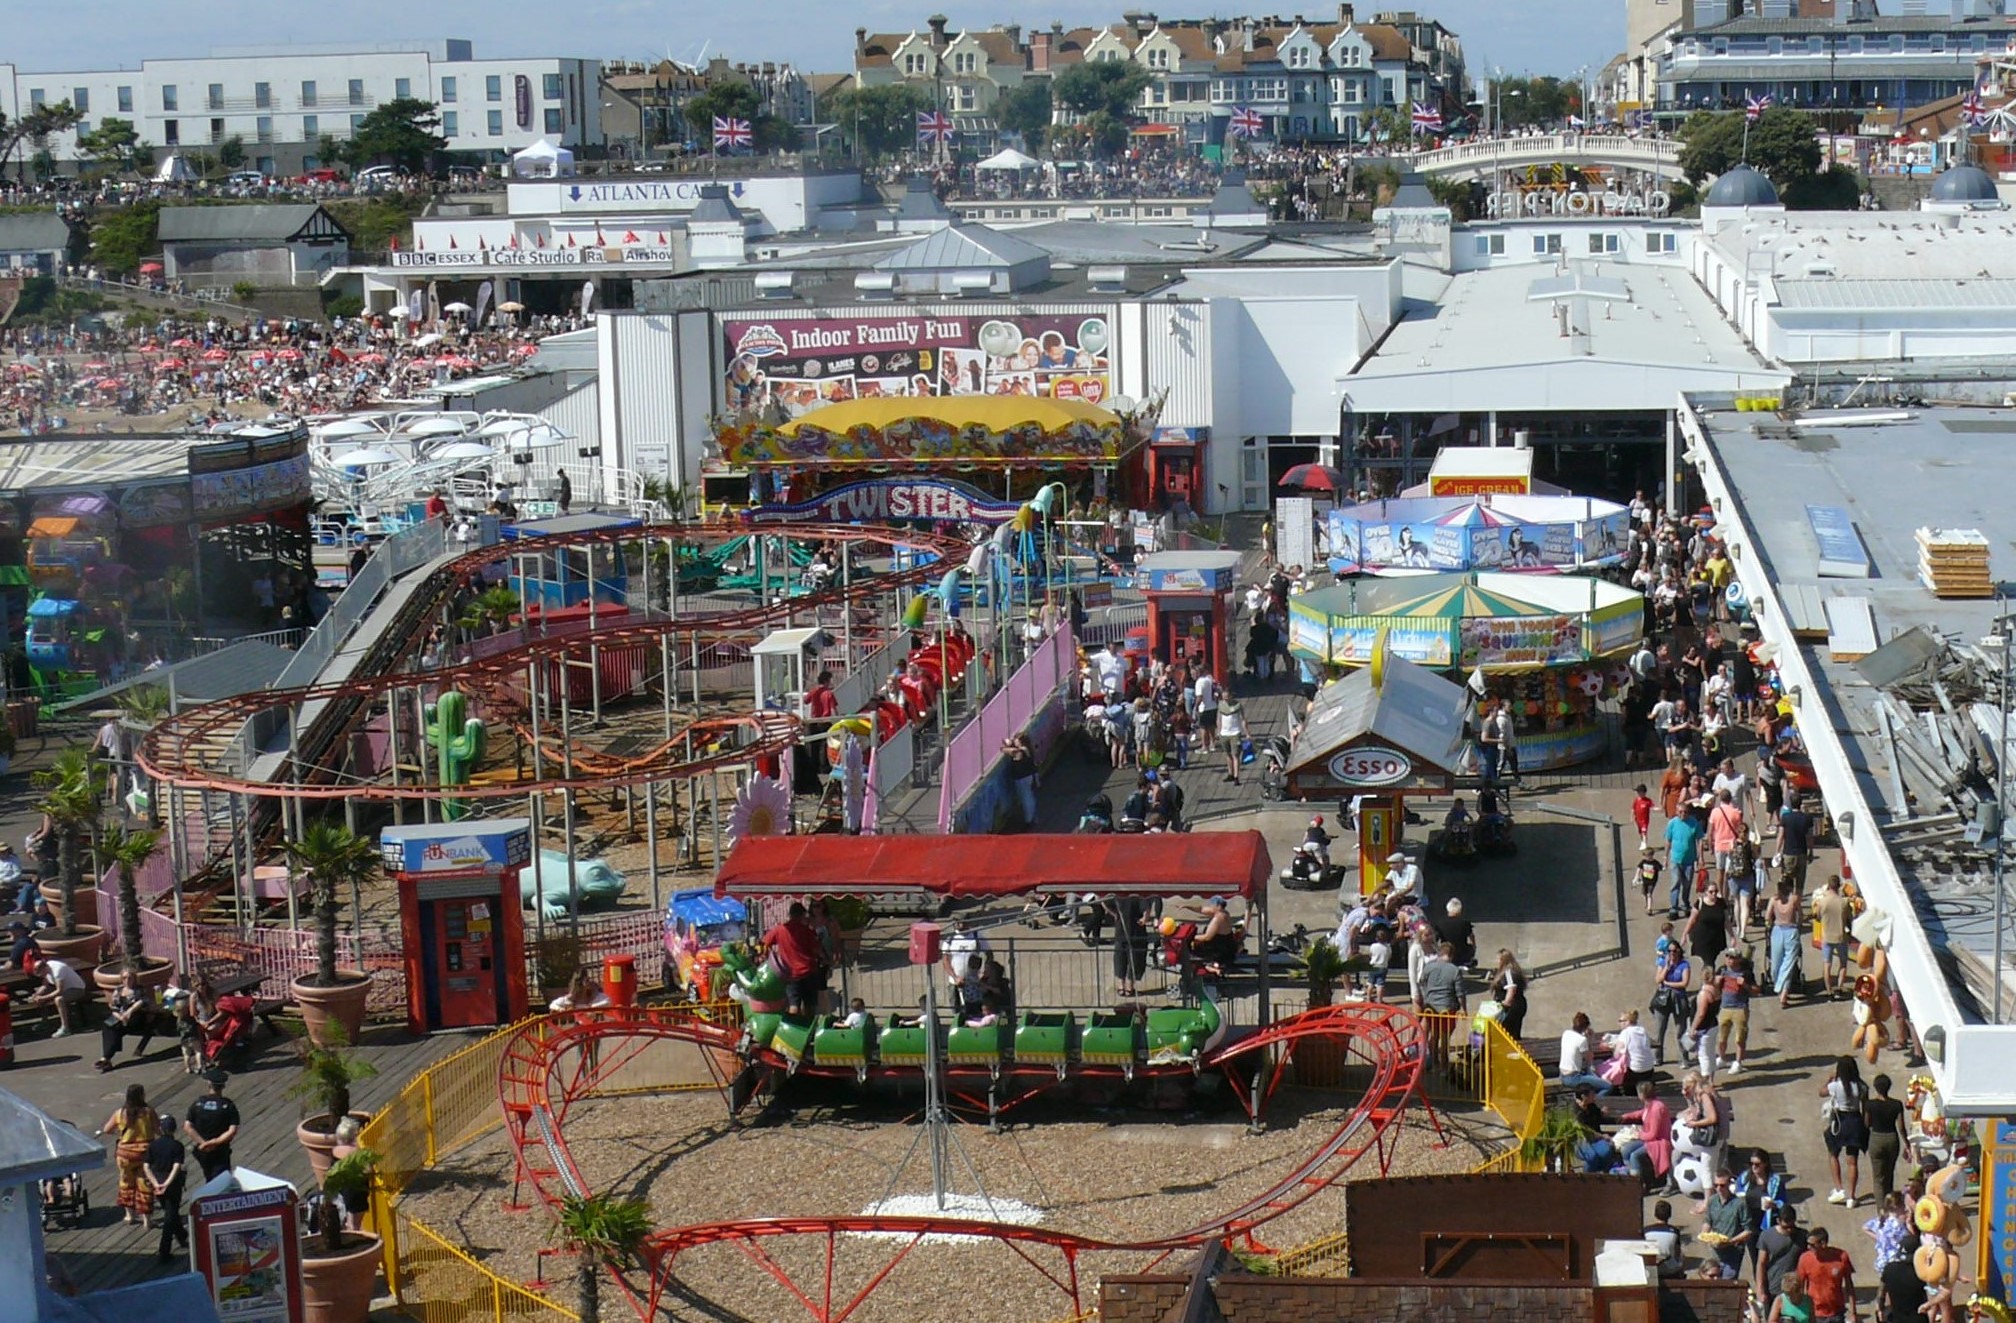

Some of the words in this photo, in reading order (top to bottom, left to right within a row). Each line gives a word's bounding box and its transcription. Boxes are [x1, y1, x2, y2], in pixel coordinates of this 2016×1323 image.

[588, 184, 671, 201] ATLANTA
[676, 183, 702, 200] CA
[399, 252, 436, 265] BBC
[438, 253, 475, 264] ESSEX
[529, 251, 575, 264] Studio
[586, 250, 603, 261] Ra
[791, 327, 851, 349] Indoor
[856, 321, 919, 344] Family
[925, 320, 962, 339] Fun
[1454, 484, 1474, 494] ICE
[1478, 484, 1519, 494] CREAM
[822, 485, 970, 520] TWISTER
[201, 1189, 289, 1215] ENTERTAINMENT
